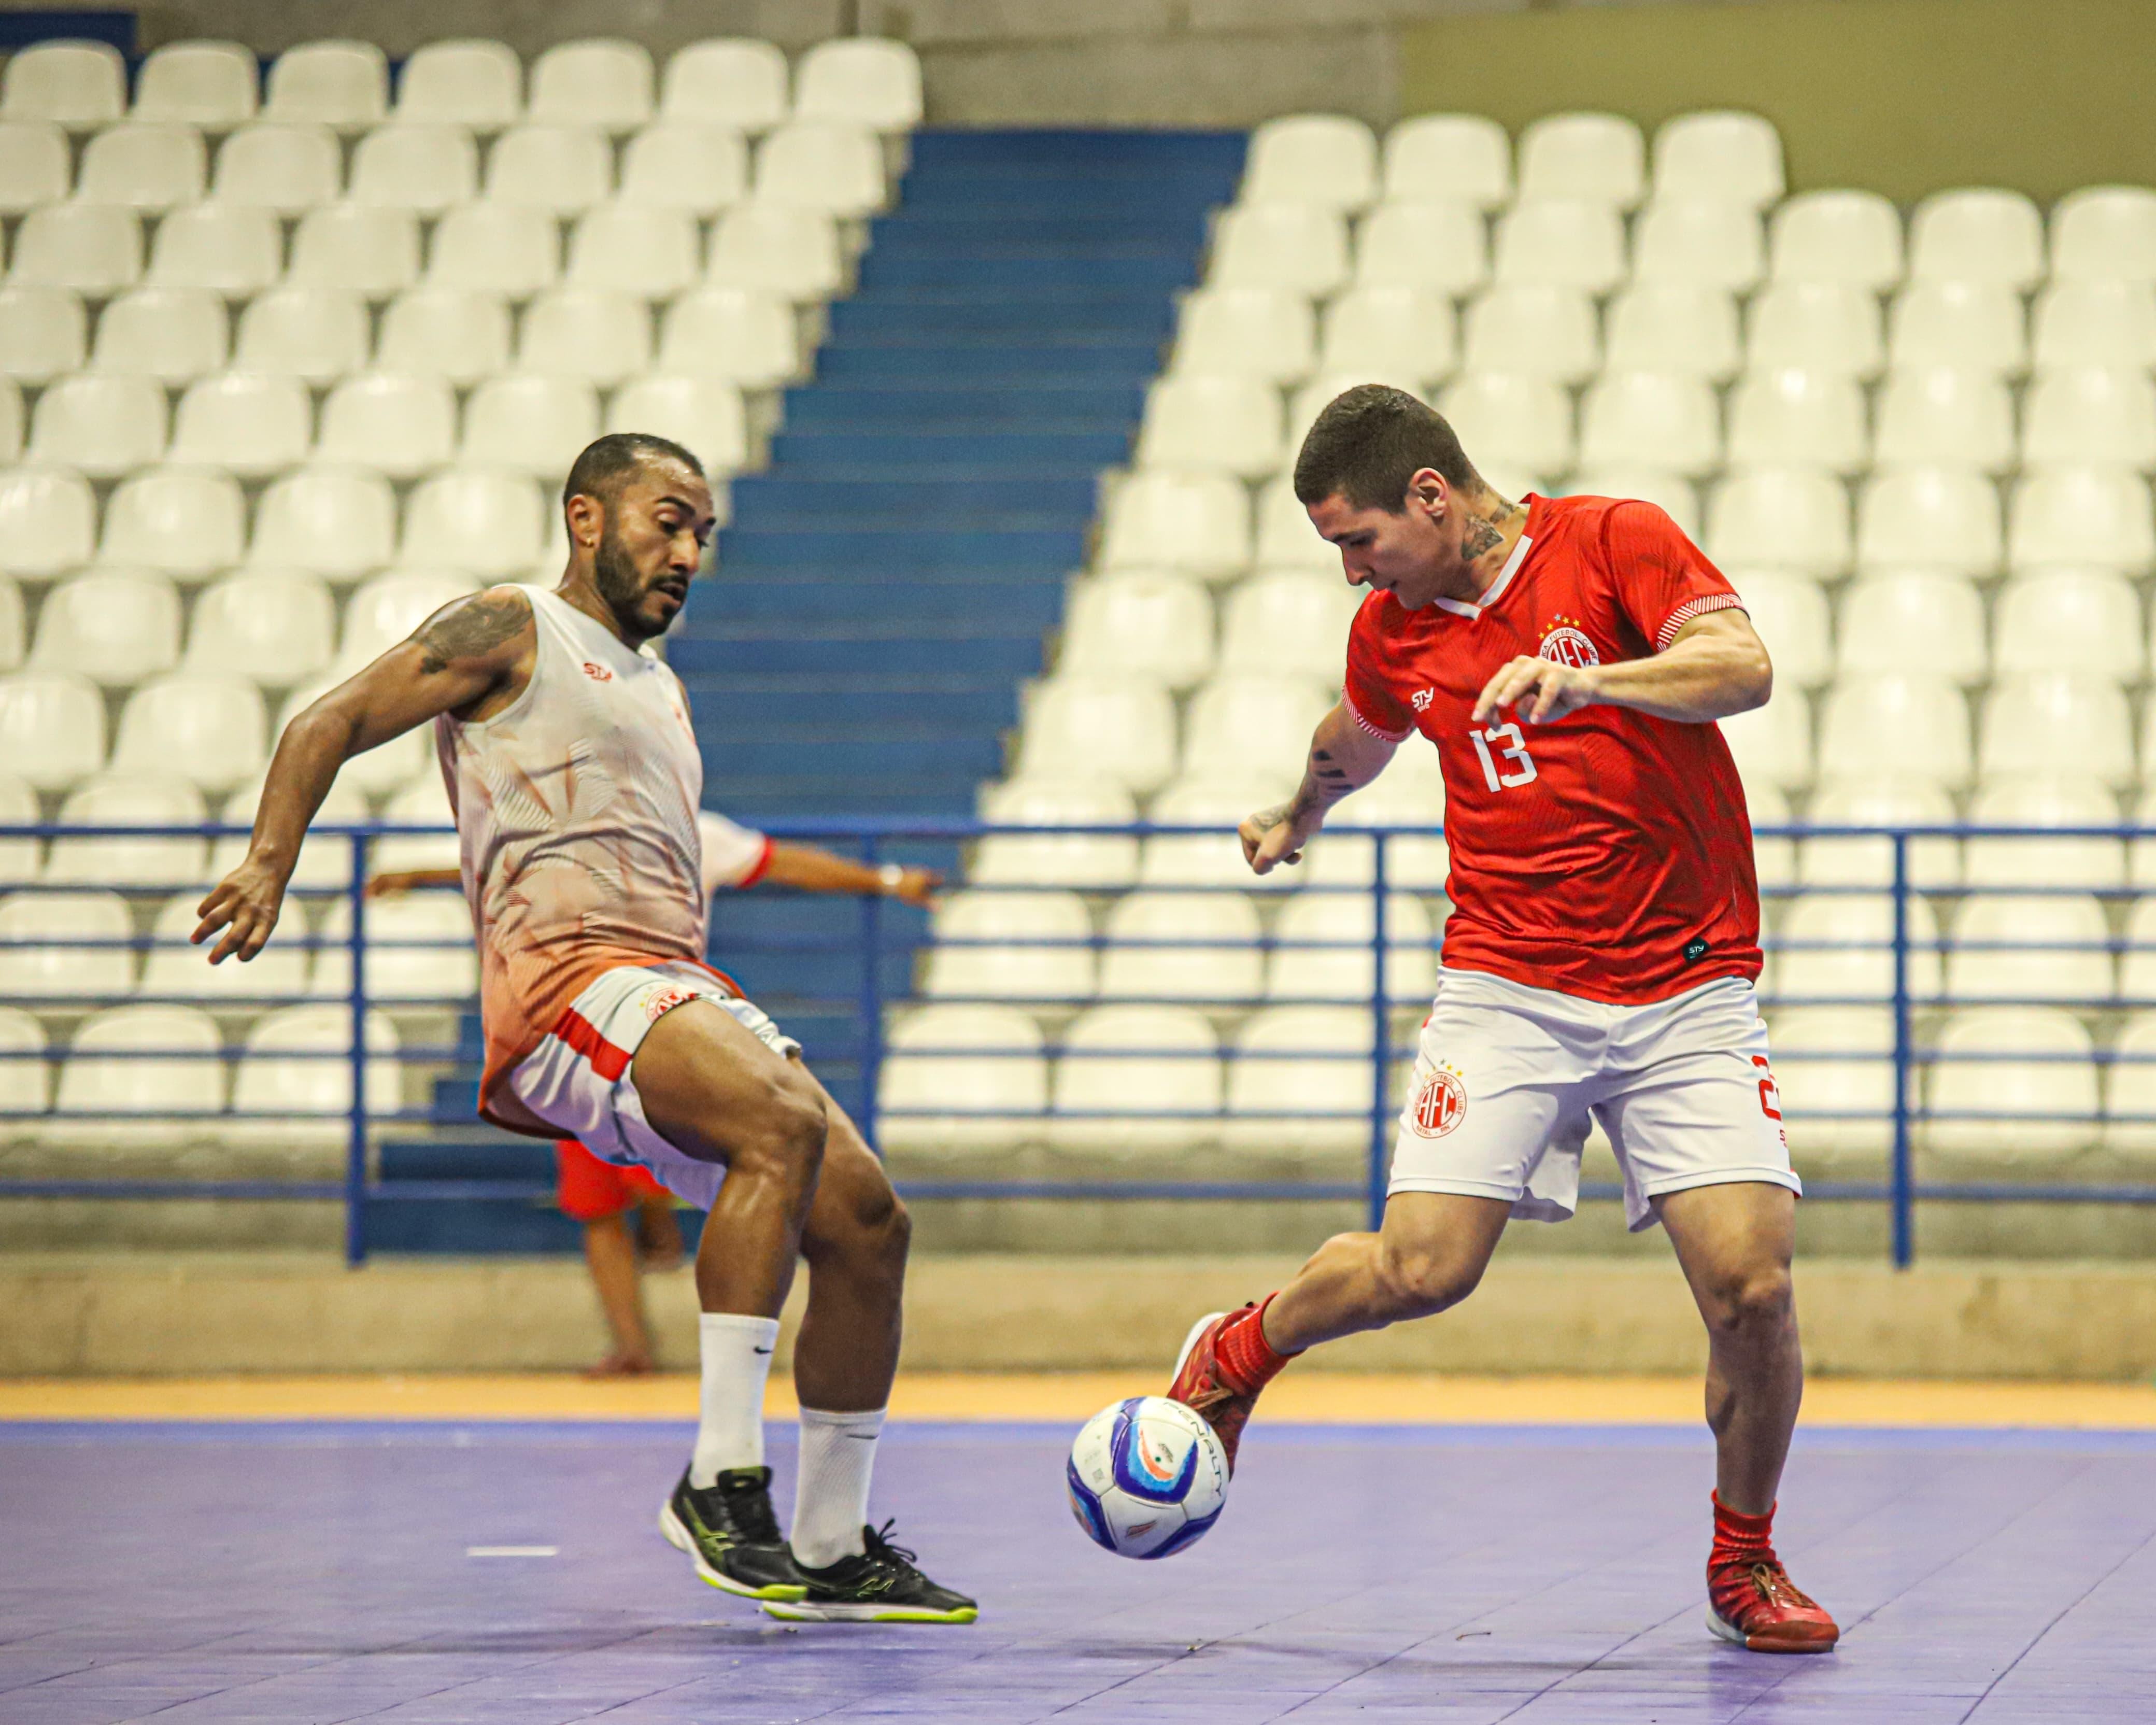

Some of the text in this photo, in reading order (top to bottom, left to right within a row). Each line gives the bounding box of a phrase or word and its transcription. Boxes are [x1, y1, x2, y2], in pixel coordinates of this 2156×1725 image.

[1549, 630, 1578, 642] FUTEBOL
[1582, 638, 1597, 659] CLUBE
[1468, 723, 1538, 793] 13
[1430, 1074, 1455, 1087] FUTEBOL
[1418, 1082, 1455, 1128] AFC
[1163, 1402, 1222, 1497] PENALTY
